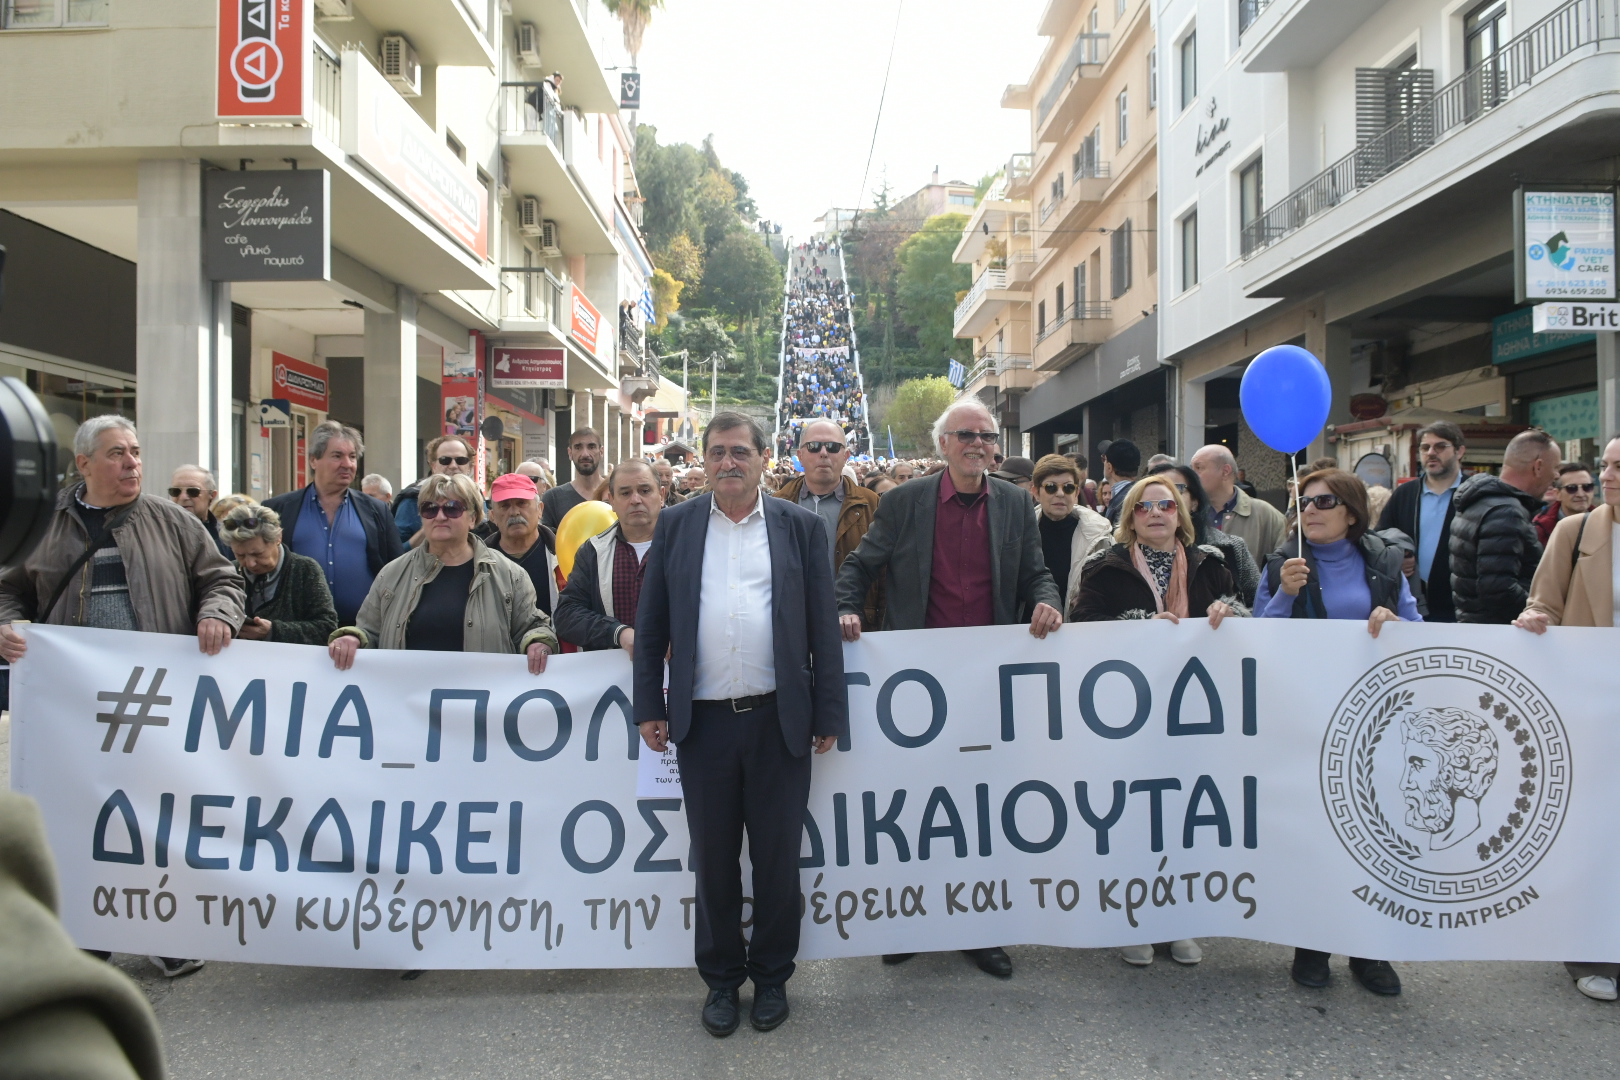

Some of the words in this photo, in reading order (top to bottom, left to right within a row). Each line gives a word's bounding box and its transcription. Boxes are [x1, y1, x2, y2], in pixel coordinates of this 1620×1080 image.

[1526, 195, 1613, 207] ΚΤΗΝΙΑΤΡΕΙΟ
[224, 233, 248, 245] cafe
[239, 244, 271, 258] γλυκό
[1574, 247, 1614, 256] PATRAS
[263, 254, 305, 268] παγωτό
[1583, 256, 1604, 264] VET
[1577, 264, 1610, 273] CARE
[1572, 306, 1618, 327] Brit
[92, 787, 523, 876] ΔΙΕΚΔΙΚΕΙ
[560, 798, 695, 874] ΟΣ
[92, 877, 178, 923] από
[196, 893, 276, 945] την
[295, 877, 564, 951] κυβέρνηση,
[583, 893, 661, 950] την
[945, 875, 1011, 914] και
[1030, 875, 1081, 912] το
[1099, 856, 1258, 927] κράτος
[1351, 884, 1433, 929] ΔΗΜΟΣ
[1438, 885, 1540, 929] ΠΑΤΡΕΩΝ
